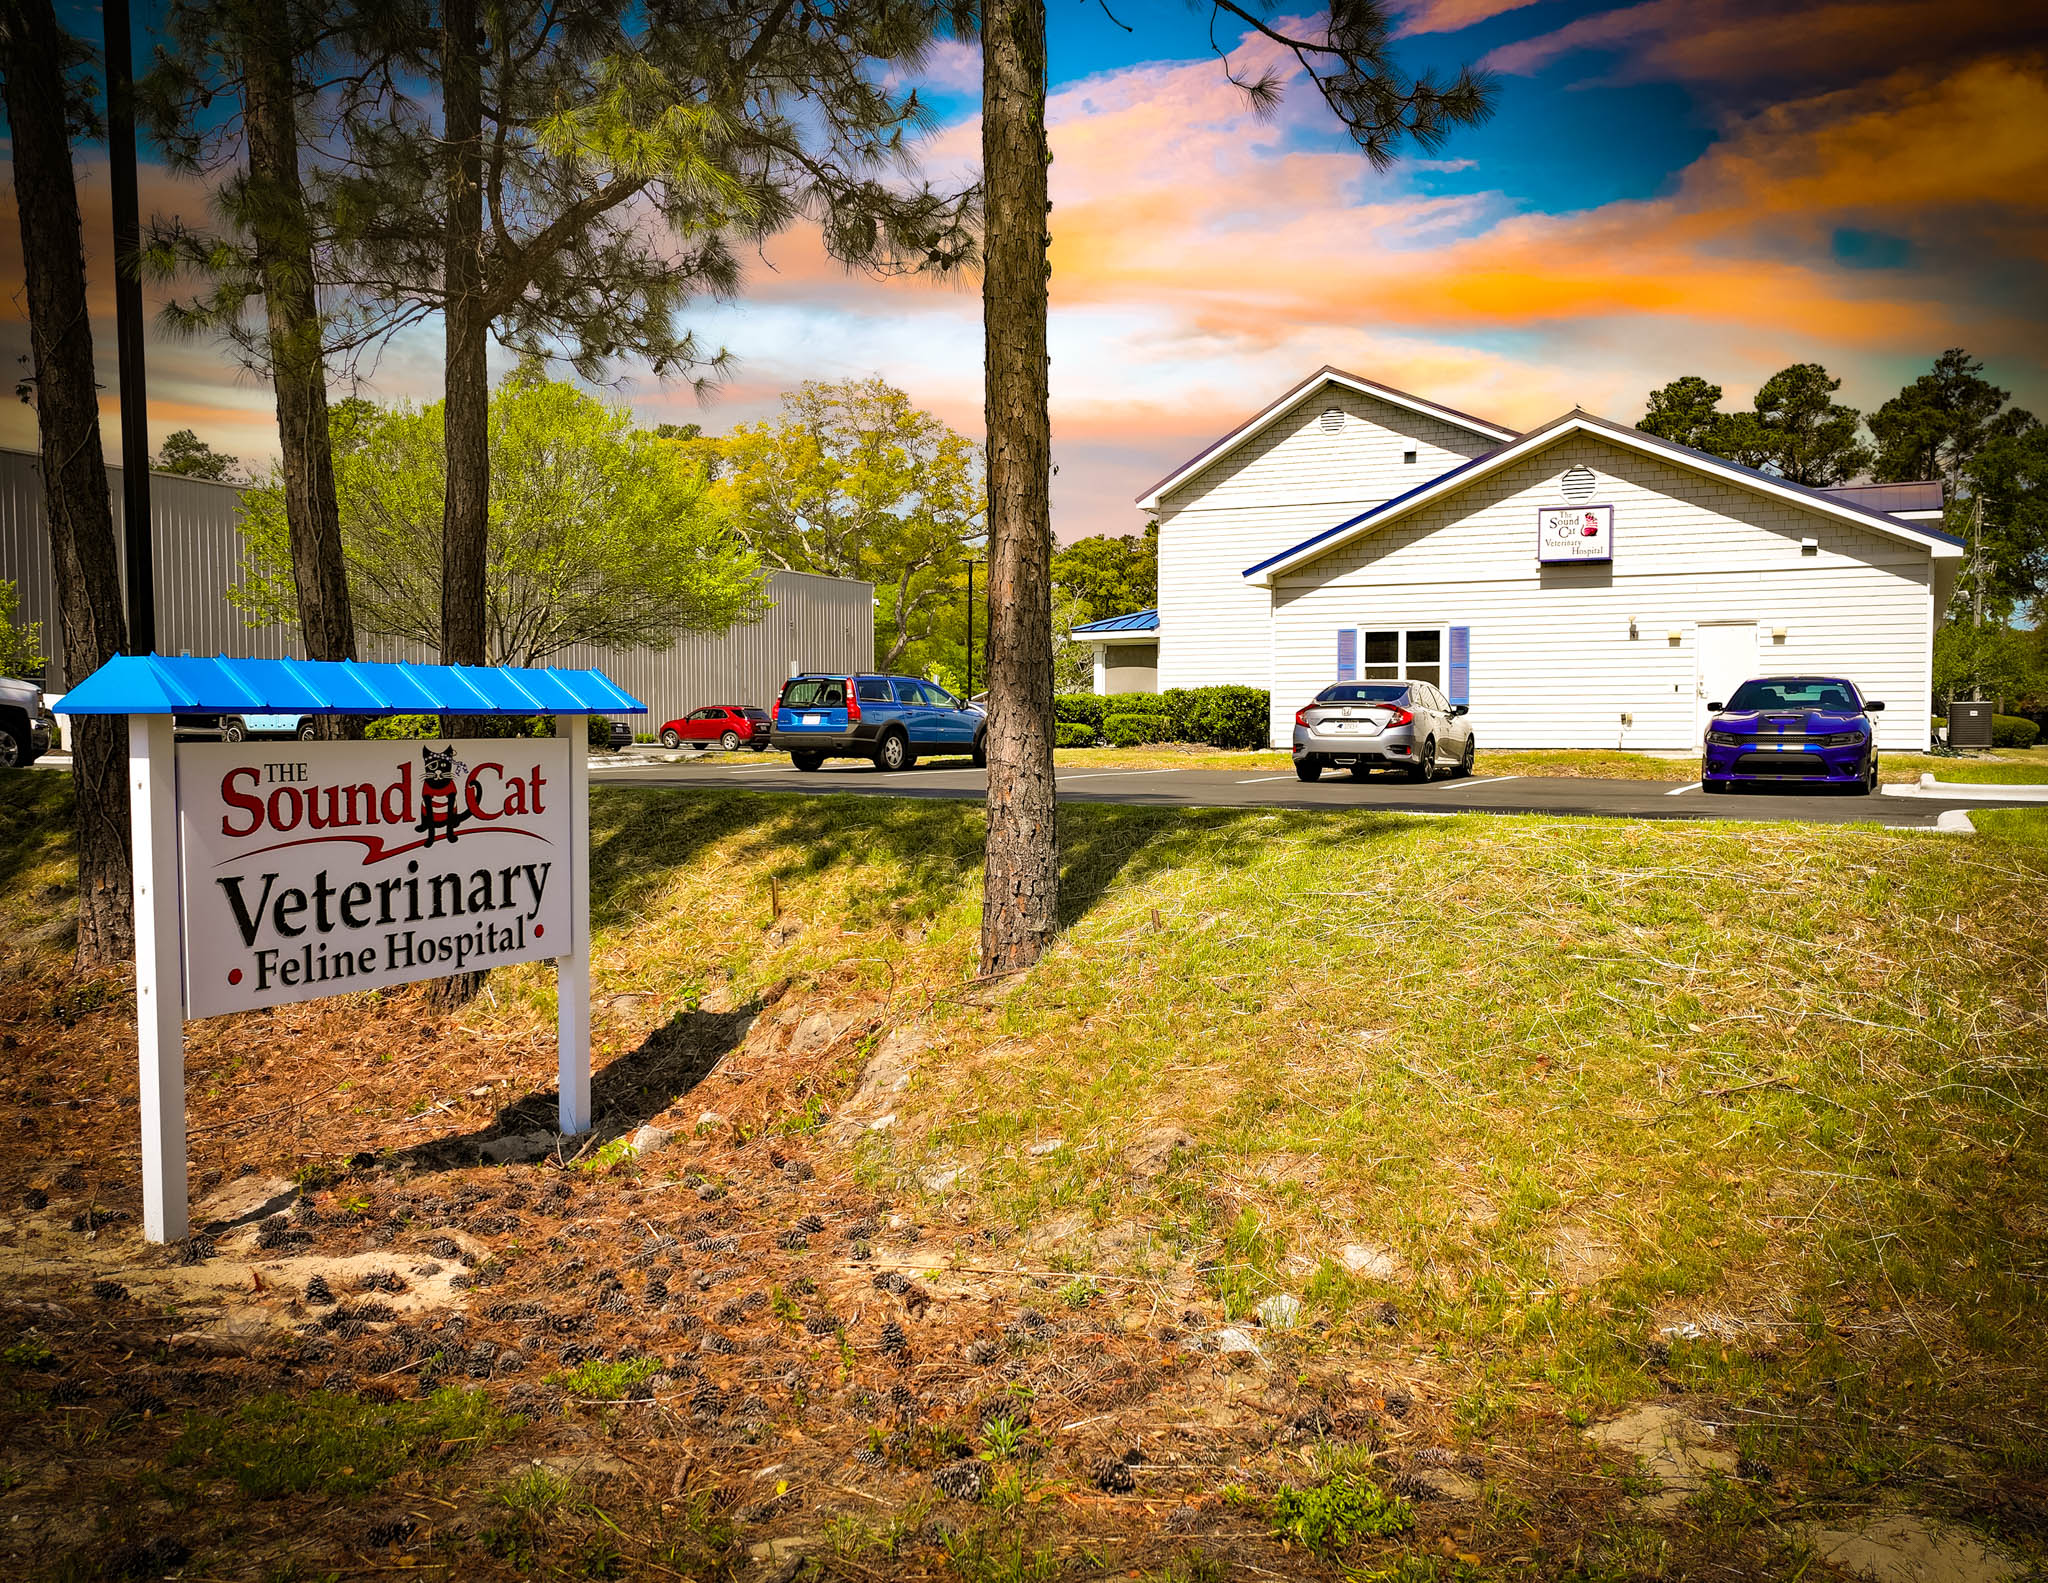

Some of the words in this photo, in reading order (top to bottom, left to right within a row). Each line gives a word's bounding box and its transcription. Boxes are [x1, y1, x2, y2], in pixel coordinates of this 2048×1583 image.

[1549, 515, 1580, 529] Sound
[1560, 511, 1573, 519] The
[1558, 526, 1576, 539] Cat
[1545, 538, 1582, 547] Veterinary
[1571, 546, 1604, 557] Hospital
[264, 762, 308, 783] THE
[221, 761, 416, 837] Sound
[465, 762, 547, 821] Cat
[216, 860, 552, 948] Veterinary
[254, 943, 377, 992] Feline
[384, 915, 526, 969] Hospital
